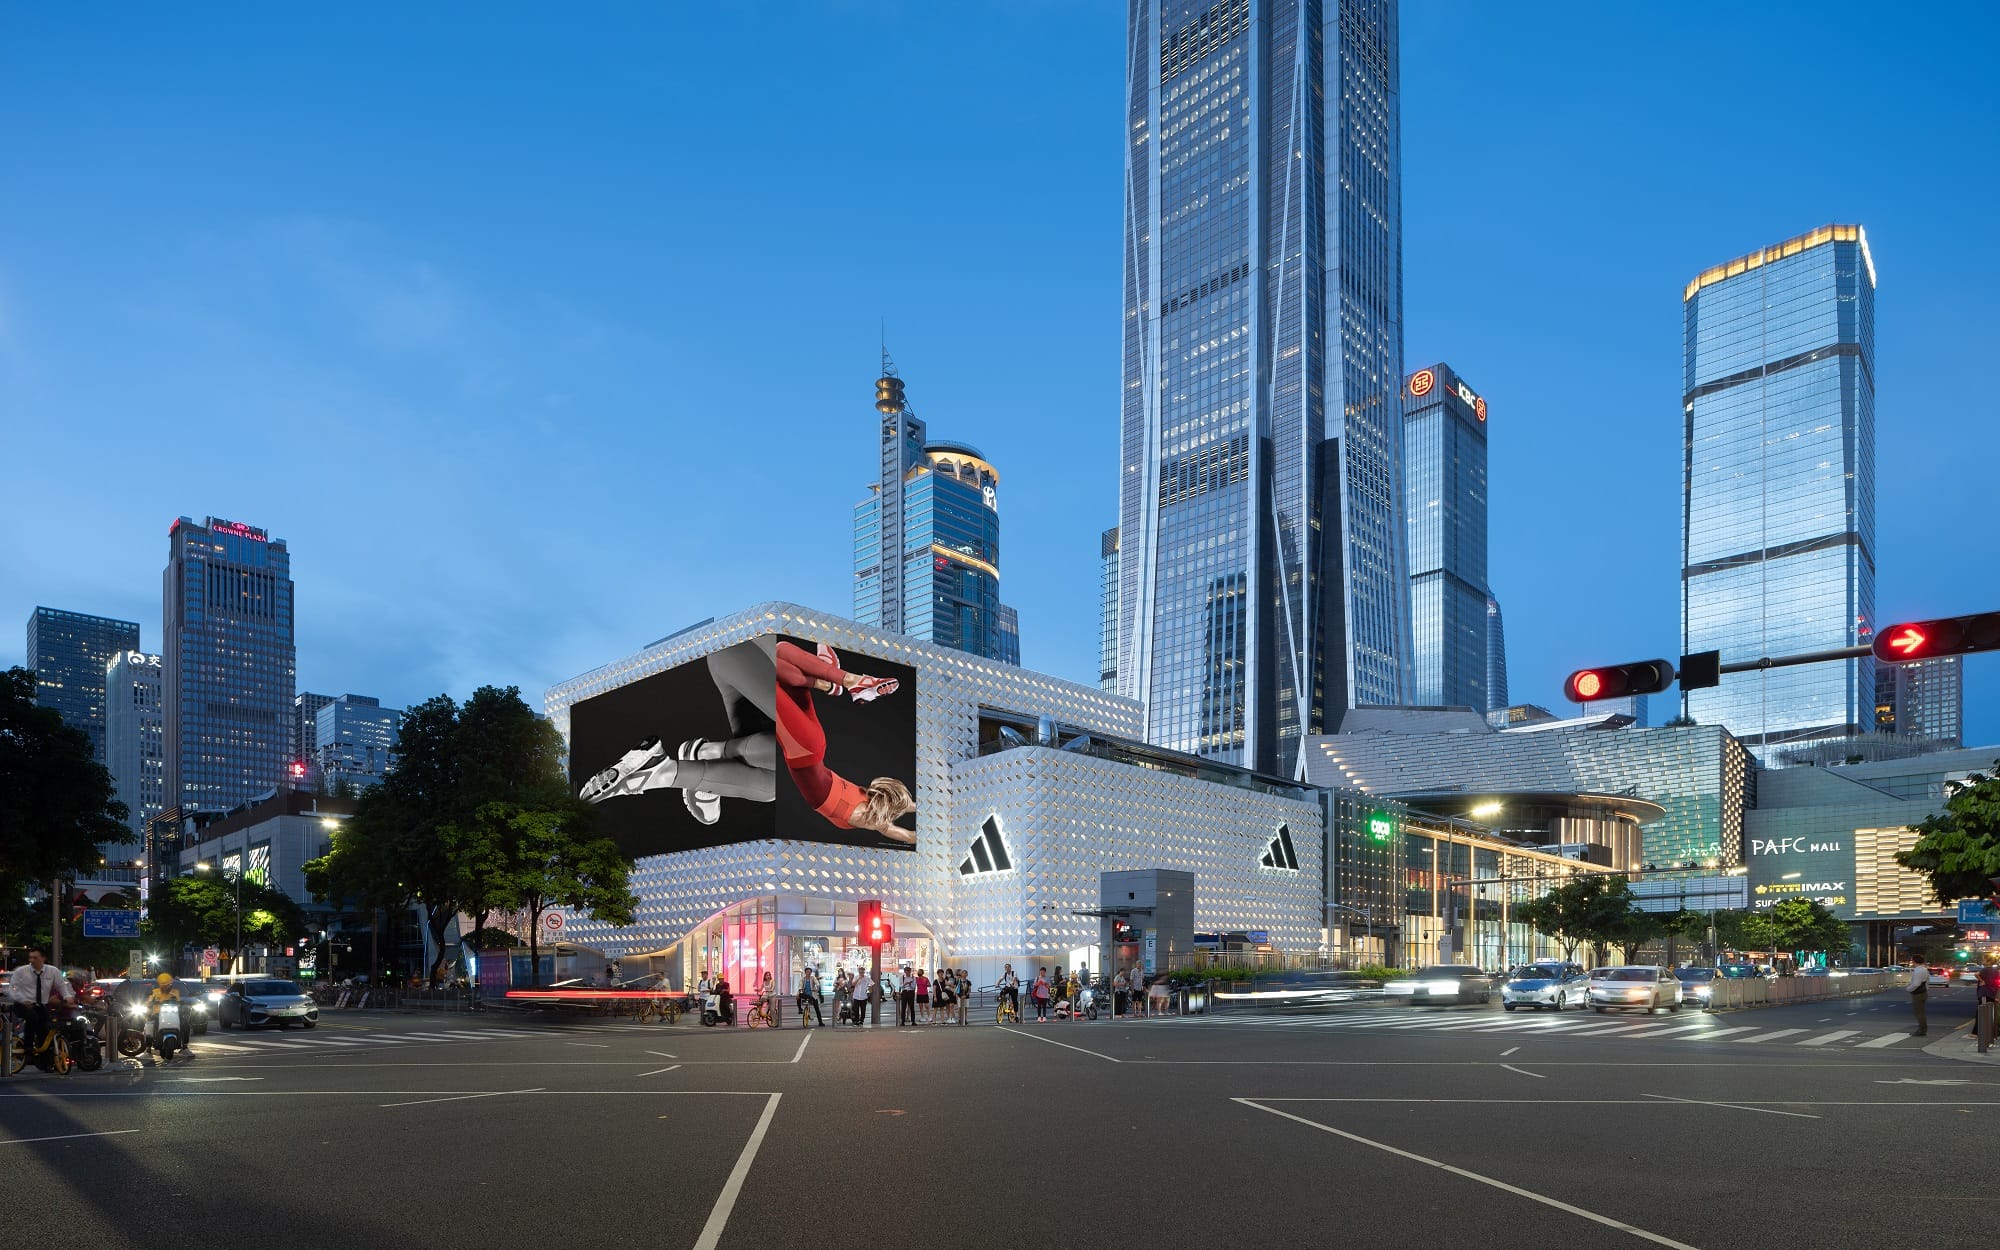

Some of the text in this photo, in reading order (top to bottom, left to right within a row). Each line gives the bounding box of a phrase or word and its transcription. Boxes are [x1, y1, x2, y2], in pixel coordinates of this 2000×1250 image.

[1458, 382, 1476, 410] ICBC
[213, 525, 267, 542] CROWNE PLAZA
[148, 654, 162, 668] 交
[1371, 819, 1390, 836] COCO
[1751, 837, 1841, 856] PAFC MALL
[1801, 882, 1844, 892] IMAX
[1148, 940, 1153, 948] E
